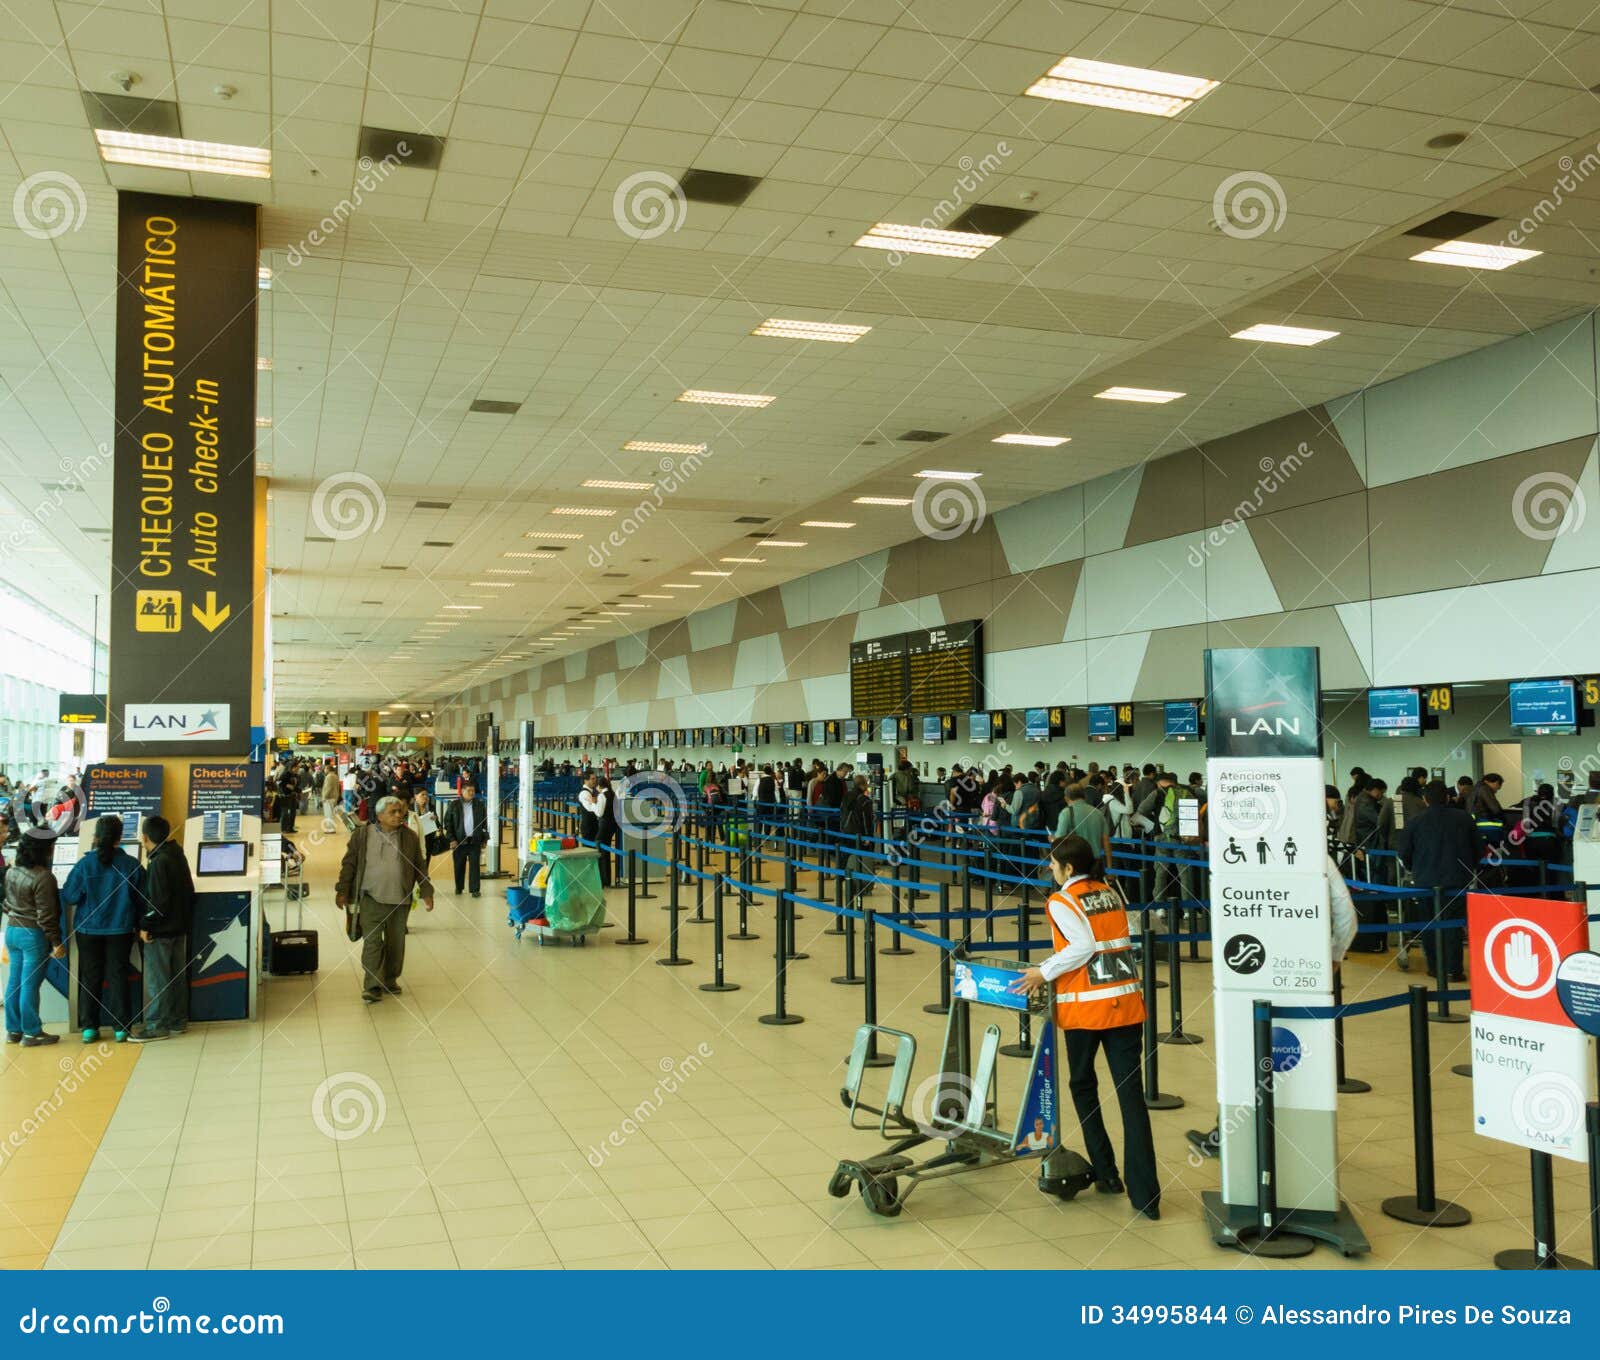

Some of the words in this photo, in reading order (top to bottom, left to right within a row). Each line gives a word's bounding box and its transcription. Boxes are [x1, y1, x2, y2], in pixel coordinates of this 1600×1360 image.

[139, 216, 177, 414] AUTOMÁTICO
[188, 378, 218, 494] check-in
[140, 432, 173, 577] CHEQUEO
[188, 512, 217, 576] Auto
[1428, 688, 1450, 711] 49
[993, 712, 1003, 727] 44
[1051, 708, 1061, 725] 45
[1119, 705, 1131, 722] 46
[133, 715, 187, 729] LAN
[1230, 717, 1300, 736] LAN
[90, 768, 148, 779] Check-in
[193, 767, 246, 778] Check-in
[1220, 771, 1281, 781] Atenciones
[1220, 783, 1276, 795] Especiales
[1220, 798, 1256, 809] Special
[1222, 886, 1290, 901] Counter
[1223, 903, 1262, 918] Staff
[1268, 904, 1319, 919] Travel
[1272, 957, 1295, 969] 2do
[1299, 958, 1321, 970] Piso
[1272, 976, 1290, 987] Of.
[1294, 976, 1317, 988] 250
[1475, 1025, 1495, 1042] No
[1499, 1032, 1545, 1052] entrar
[1272, 1046, 1300, 1054] world
[1475, 1047, 1494, 1064] No
[1498, 1053, 1533, 1074] entry
[1525, 1128, 1556, 1144] LAN
